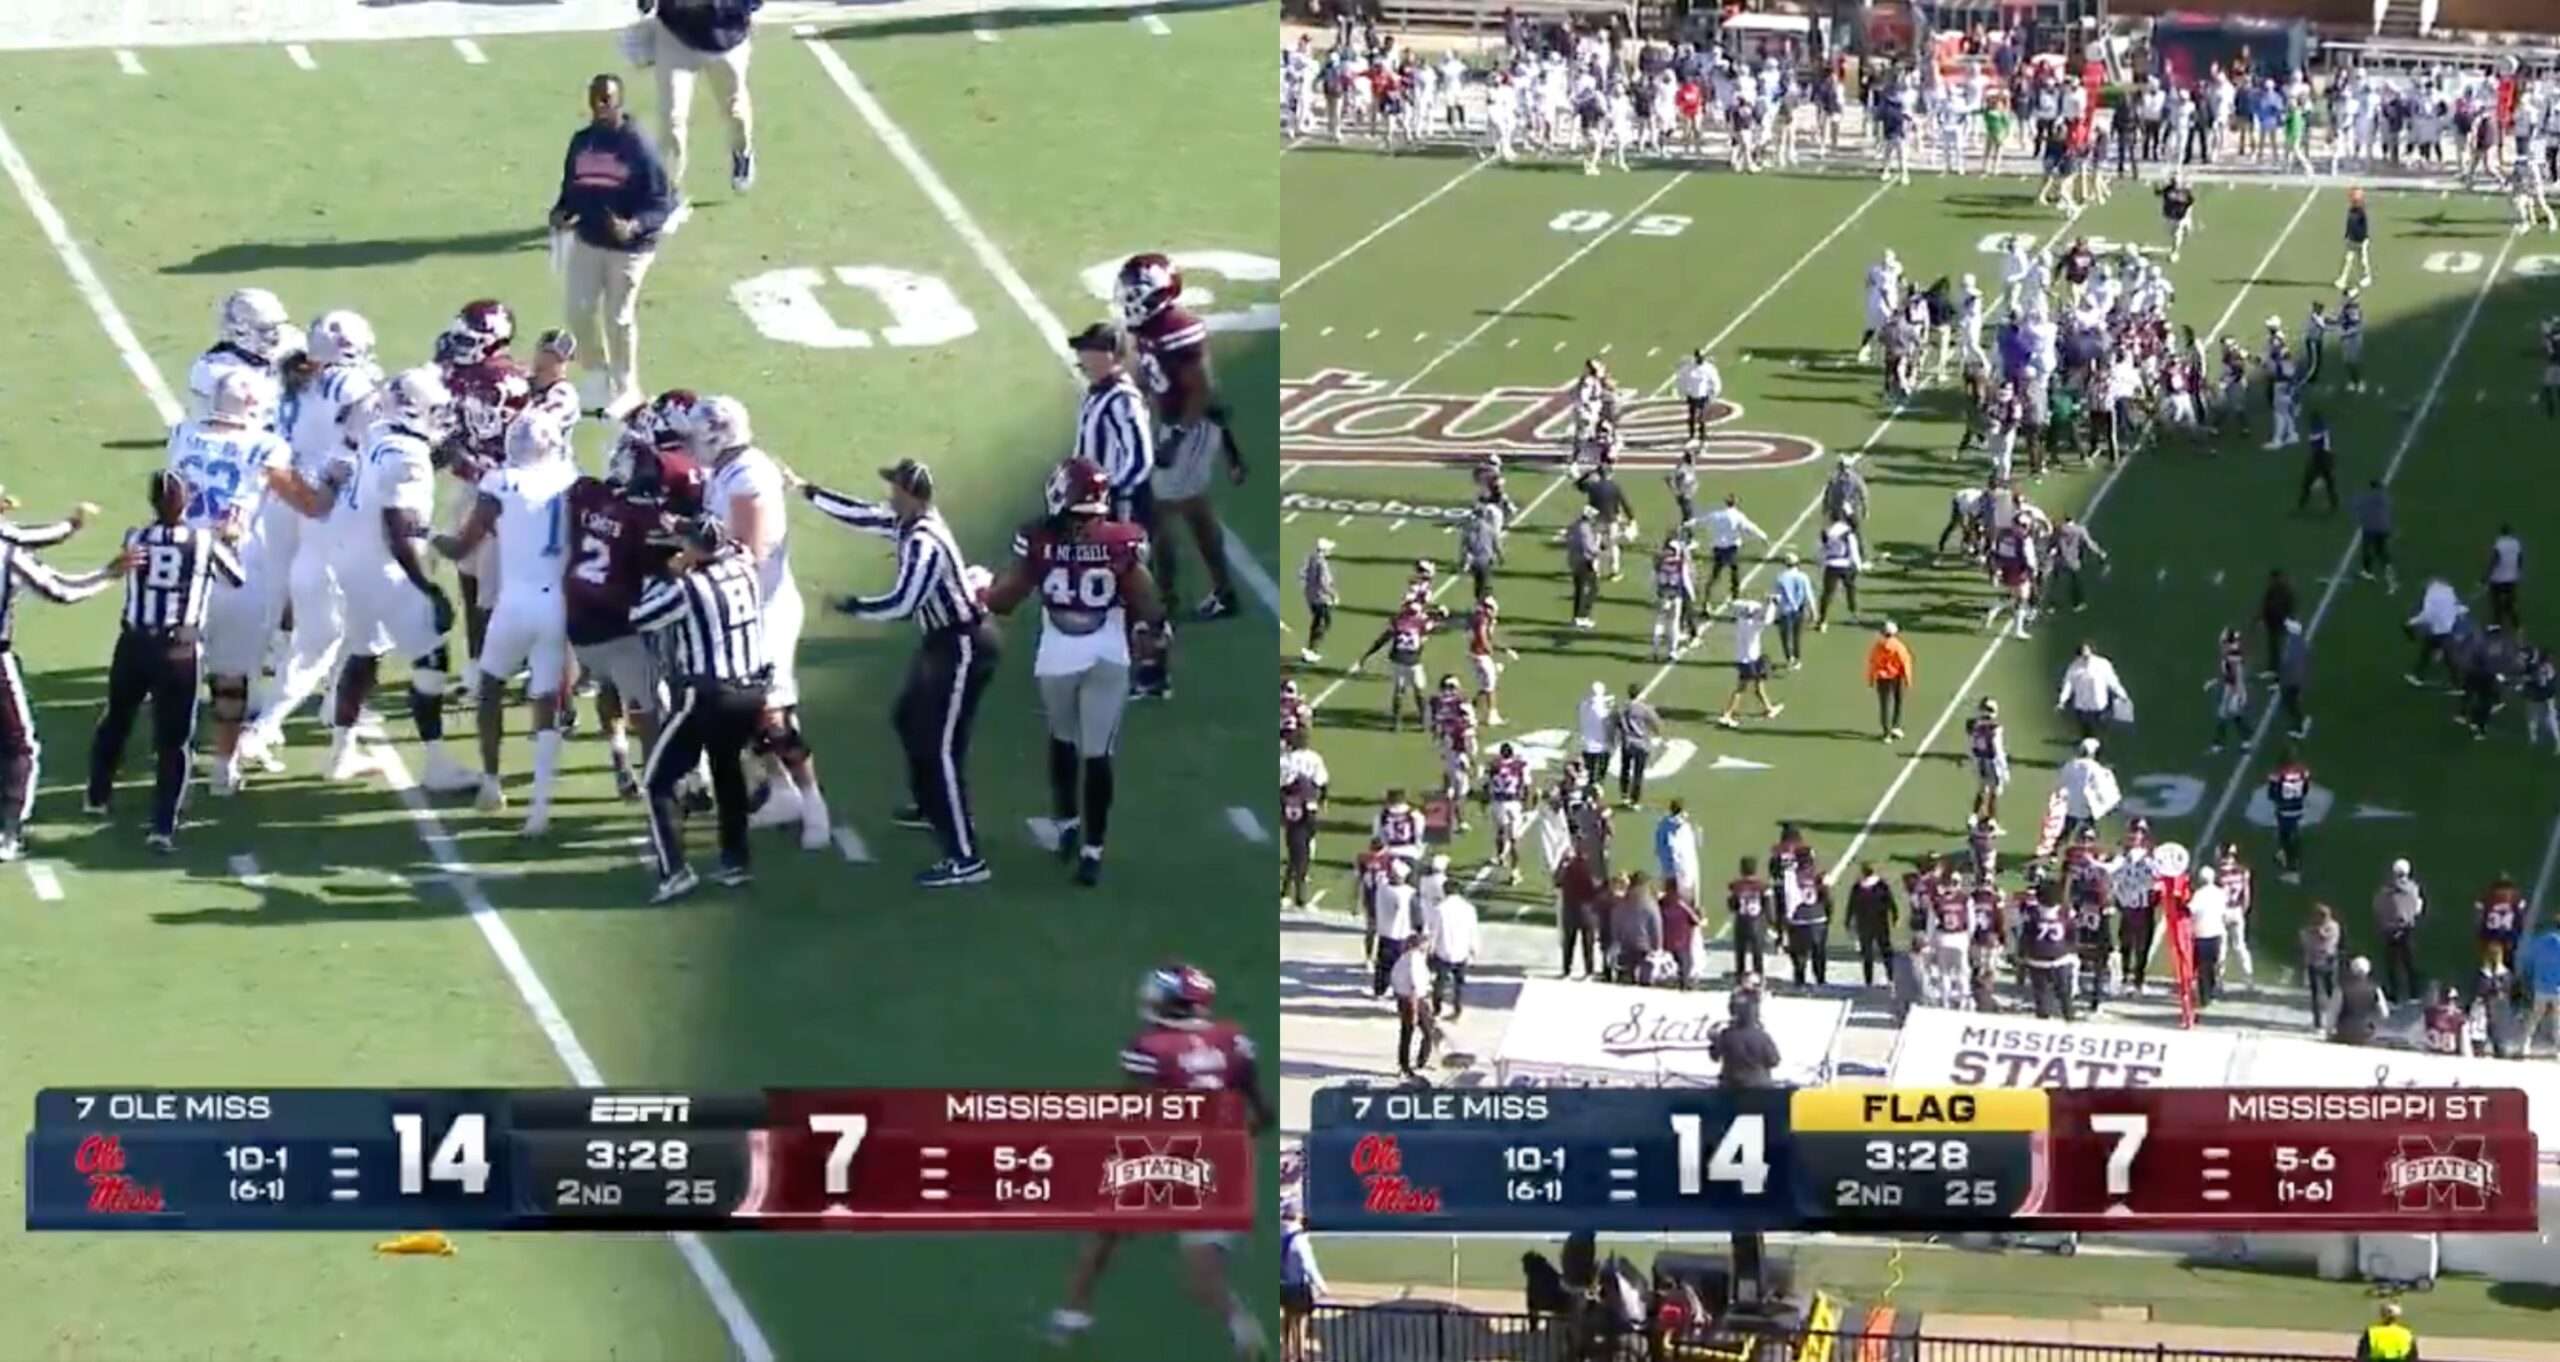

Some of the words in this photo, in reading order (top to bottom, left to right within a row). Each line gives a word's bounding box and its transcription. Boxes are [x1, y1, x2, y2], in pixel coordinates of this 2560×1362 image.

[1281, 493, 1474, 517] faceboo
[1043, 567, 1117, 608] 40
[1960, 1026, 2168, 1062] MISSISSIPPI
